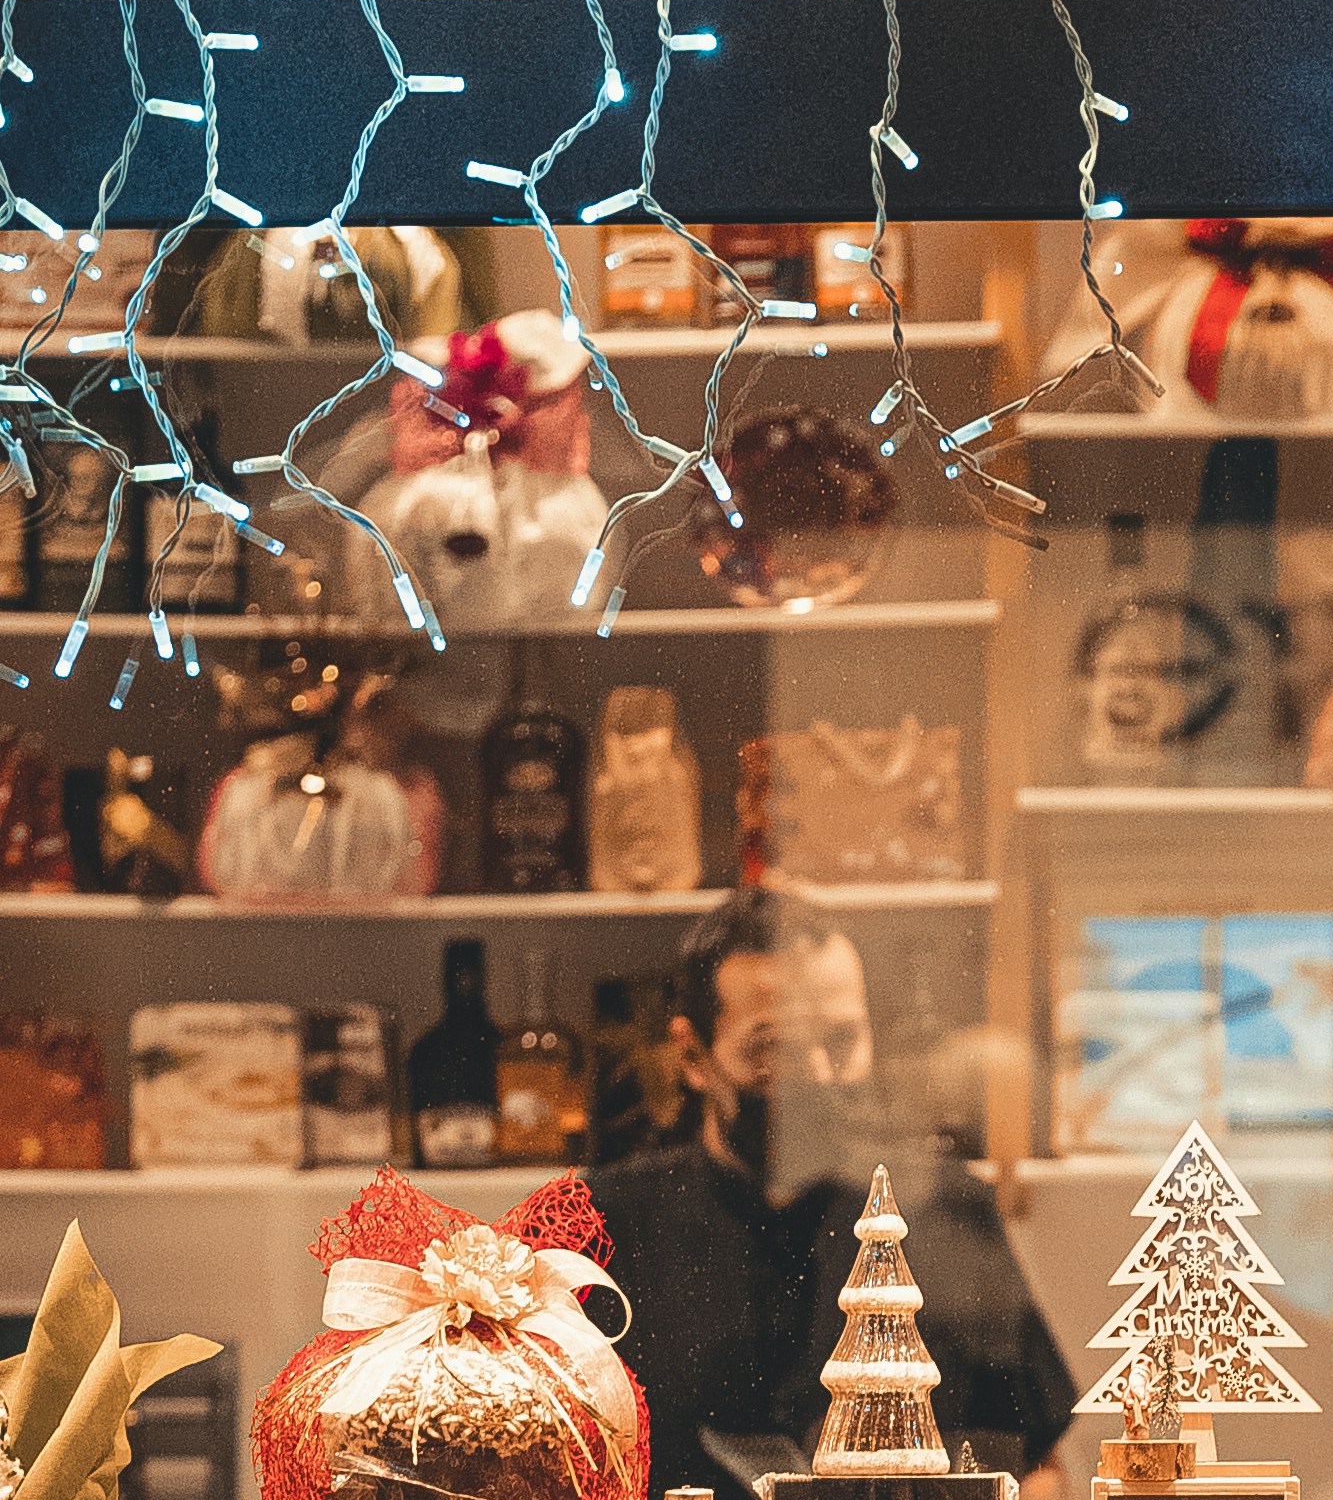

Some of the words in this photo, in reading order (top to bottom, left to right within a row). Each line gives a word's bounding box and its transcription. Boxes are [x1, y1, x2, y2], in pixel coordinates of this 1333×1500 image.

[1174, 1173, 1216, 1202] JOY
[1156, 1277, 1240, 1316] Merry
[1129, 1303, 1250, 1340] Christmas
